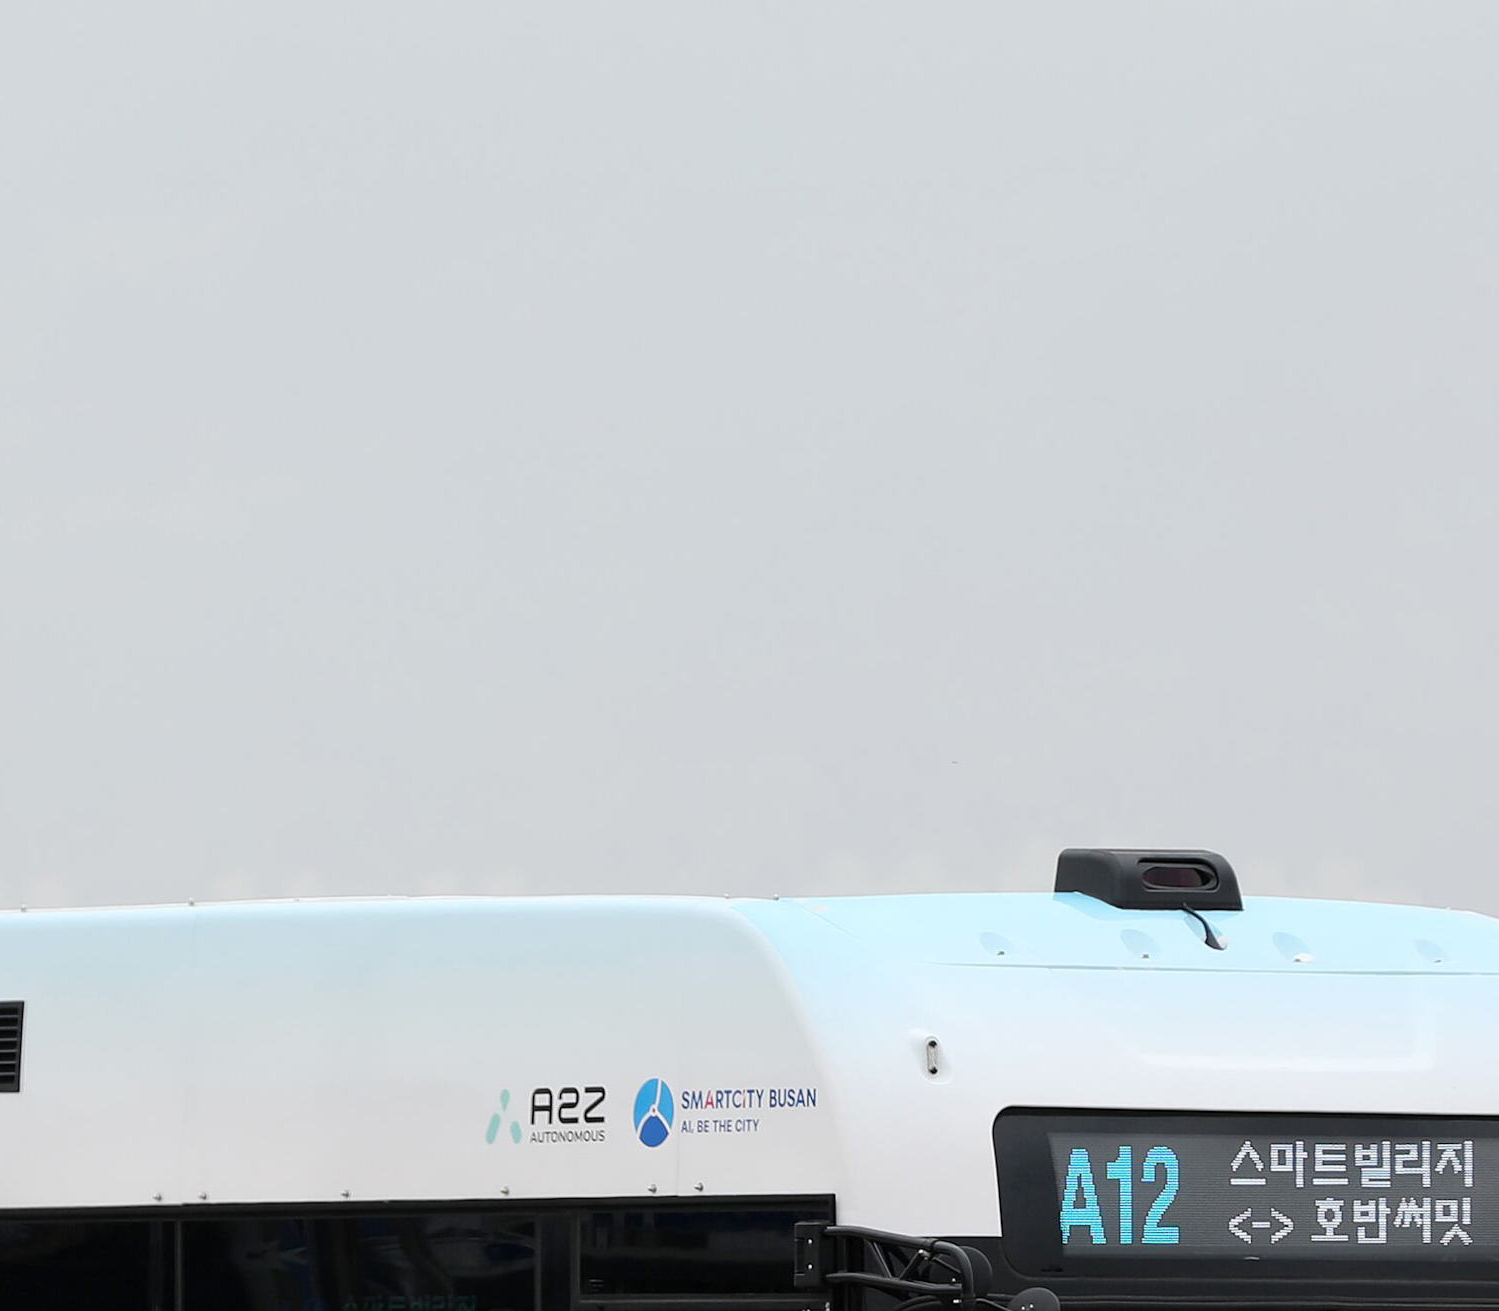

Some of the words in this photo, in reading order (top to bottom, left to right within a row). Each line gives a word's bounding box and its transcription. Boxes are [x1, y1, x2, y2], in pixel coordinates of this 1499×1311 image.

[768, 1088, 817, 1109] BUSAN
[530, 1130, 606, 1144] AUTONOMOUS
[697, 1119, 710, 1133] BE
[713, 1119, 732, 1133] THE
[735, 1118, 760, 1133] CITY
[1230, 1140, 1474, 1188] 스마트빌리지
[1059, 1145, 1181, 1245] A12
[1310, 1197, 1474, 1246] 호반써밋
